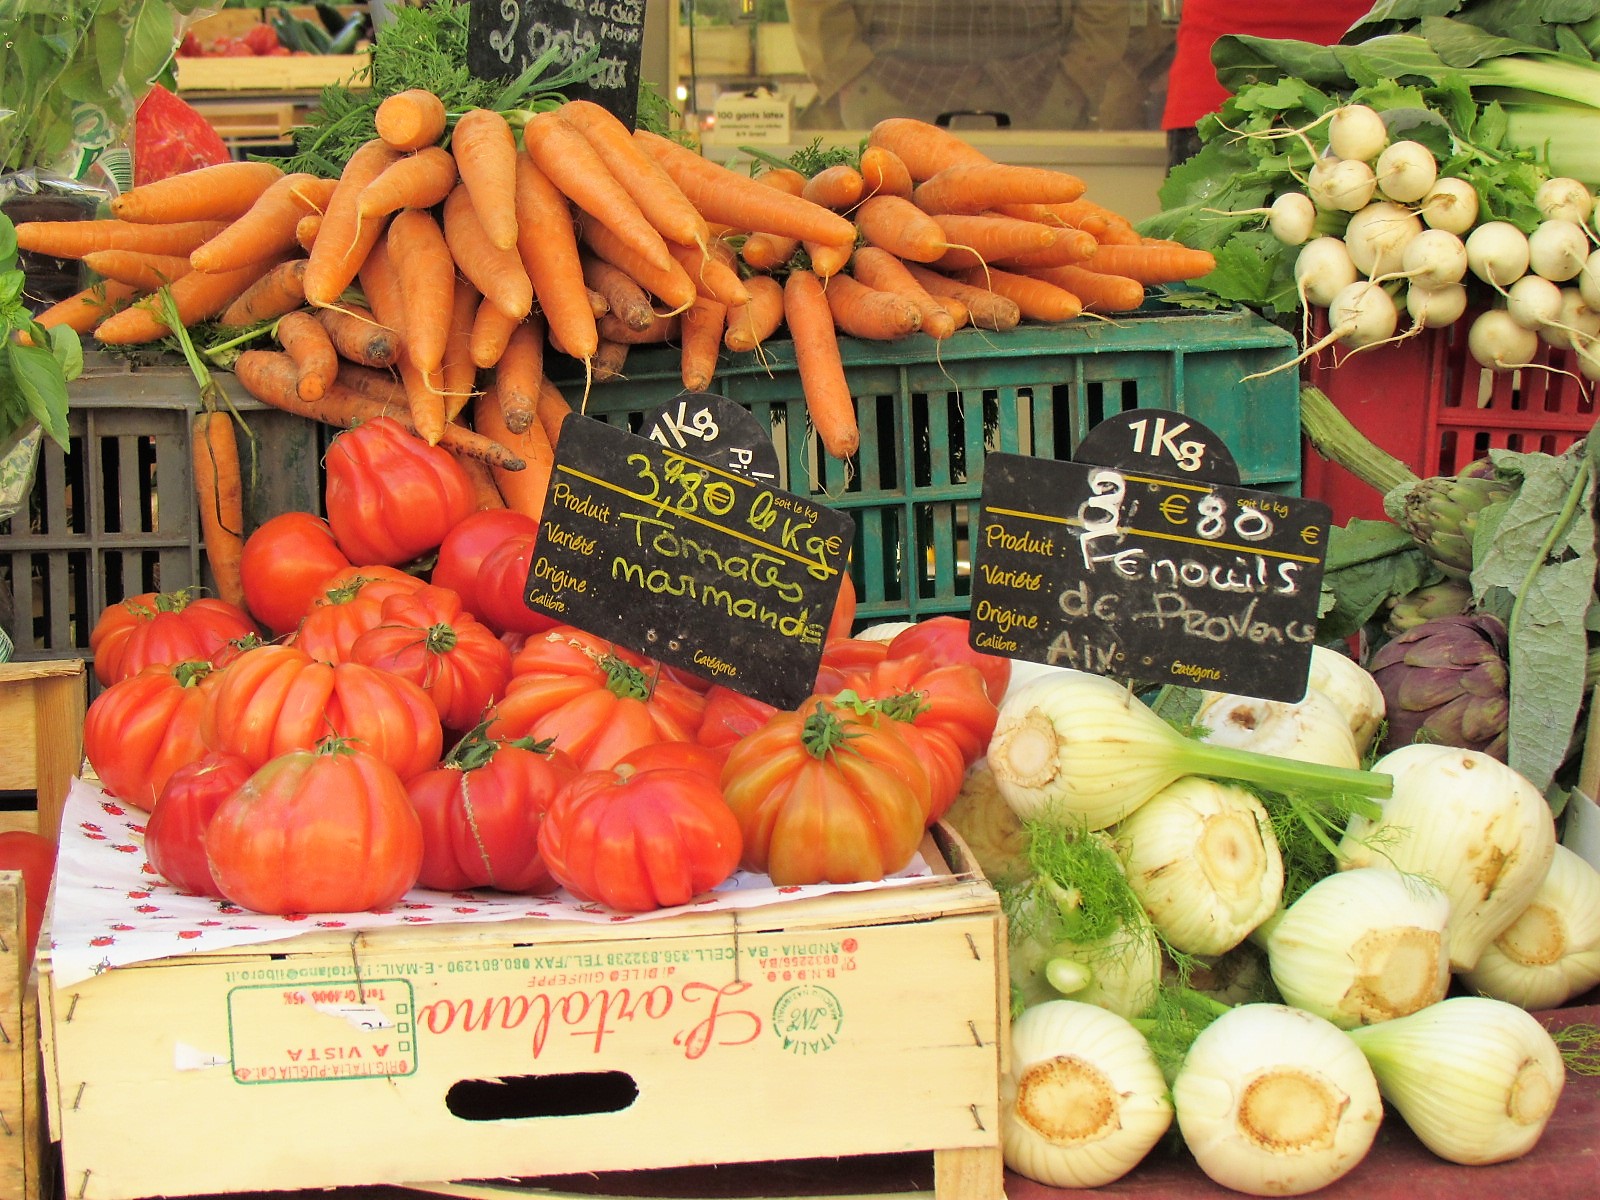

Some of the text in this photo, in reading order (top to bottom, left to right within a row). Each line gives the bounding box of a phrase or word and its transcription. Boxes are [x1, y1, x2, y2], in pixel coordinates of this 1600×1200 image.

[717, 111, 784, 121] 100 gants latex
[649, 401, 719, 449] 1Kg
[1128, 417, 1206, 472] 1Kg
[553, 482, 611, 524] Produit
[774, 497, 818, 524] soit le kg
[1236, 498, 1289, 519] soit le kg
[544, 521, 596, 556] Variété
[985, 524, 1054, 557] Produit
[533, 556, 588, 593] Origine
[980, 563, 1042, 592] Variété
[529, 588, 565, 613] Calibre
[976, 600, 1039, 633] Origine
[975, 632, 1018, 652] Calibre
[692, 649, 738, 677] Catégorie
[1171, 659, 1221, 682] Catégorie
[286, 1046, 363, 1062] VISTA
